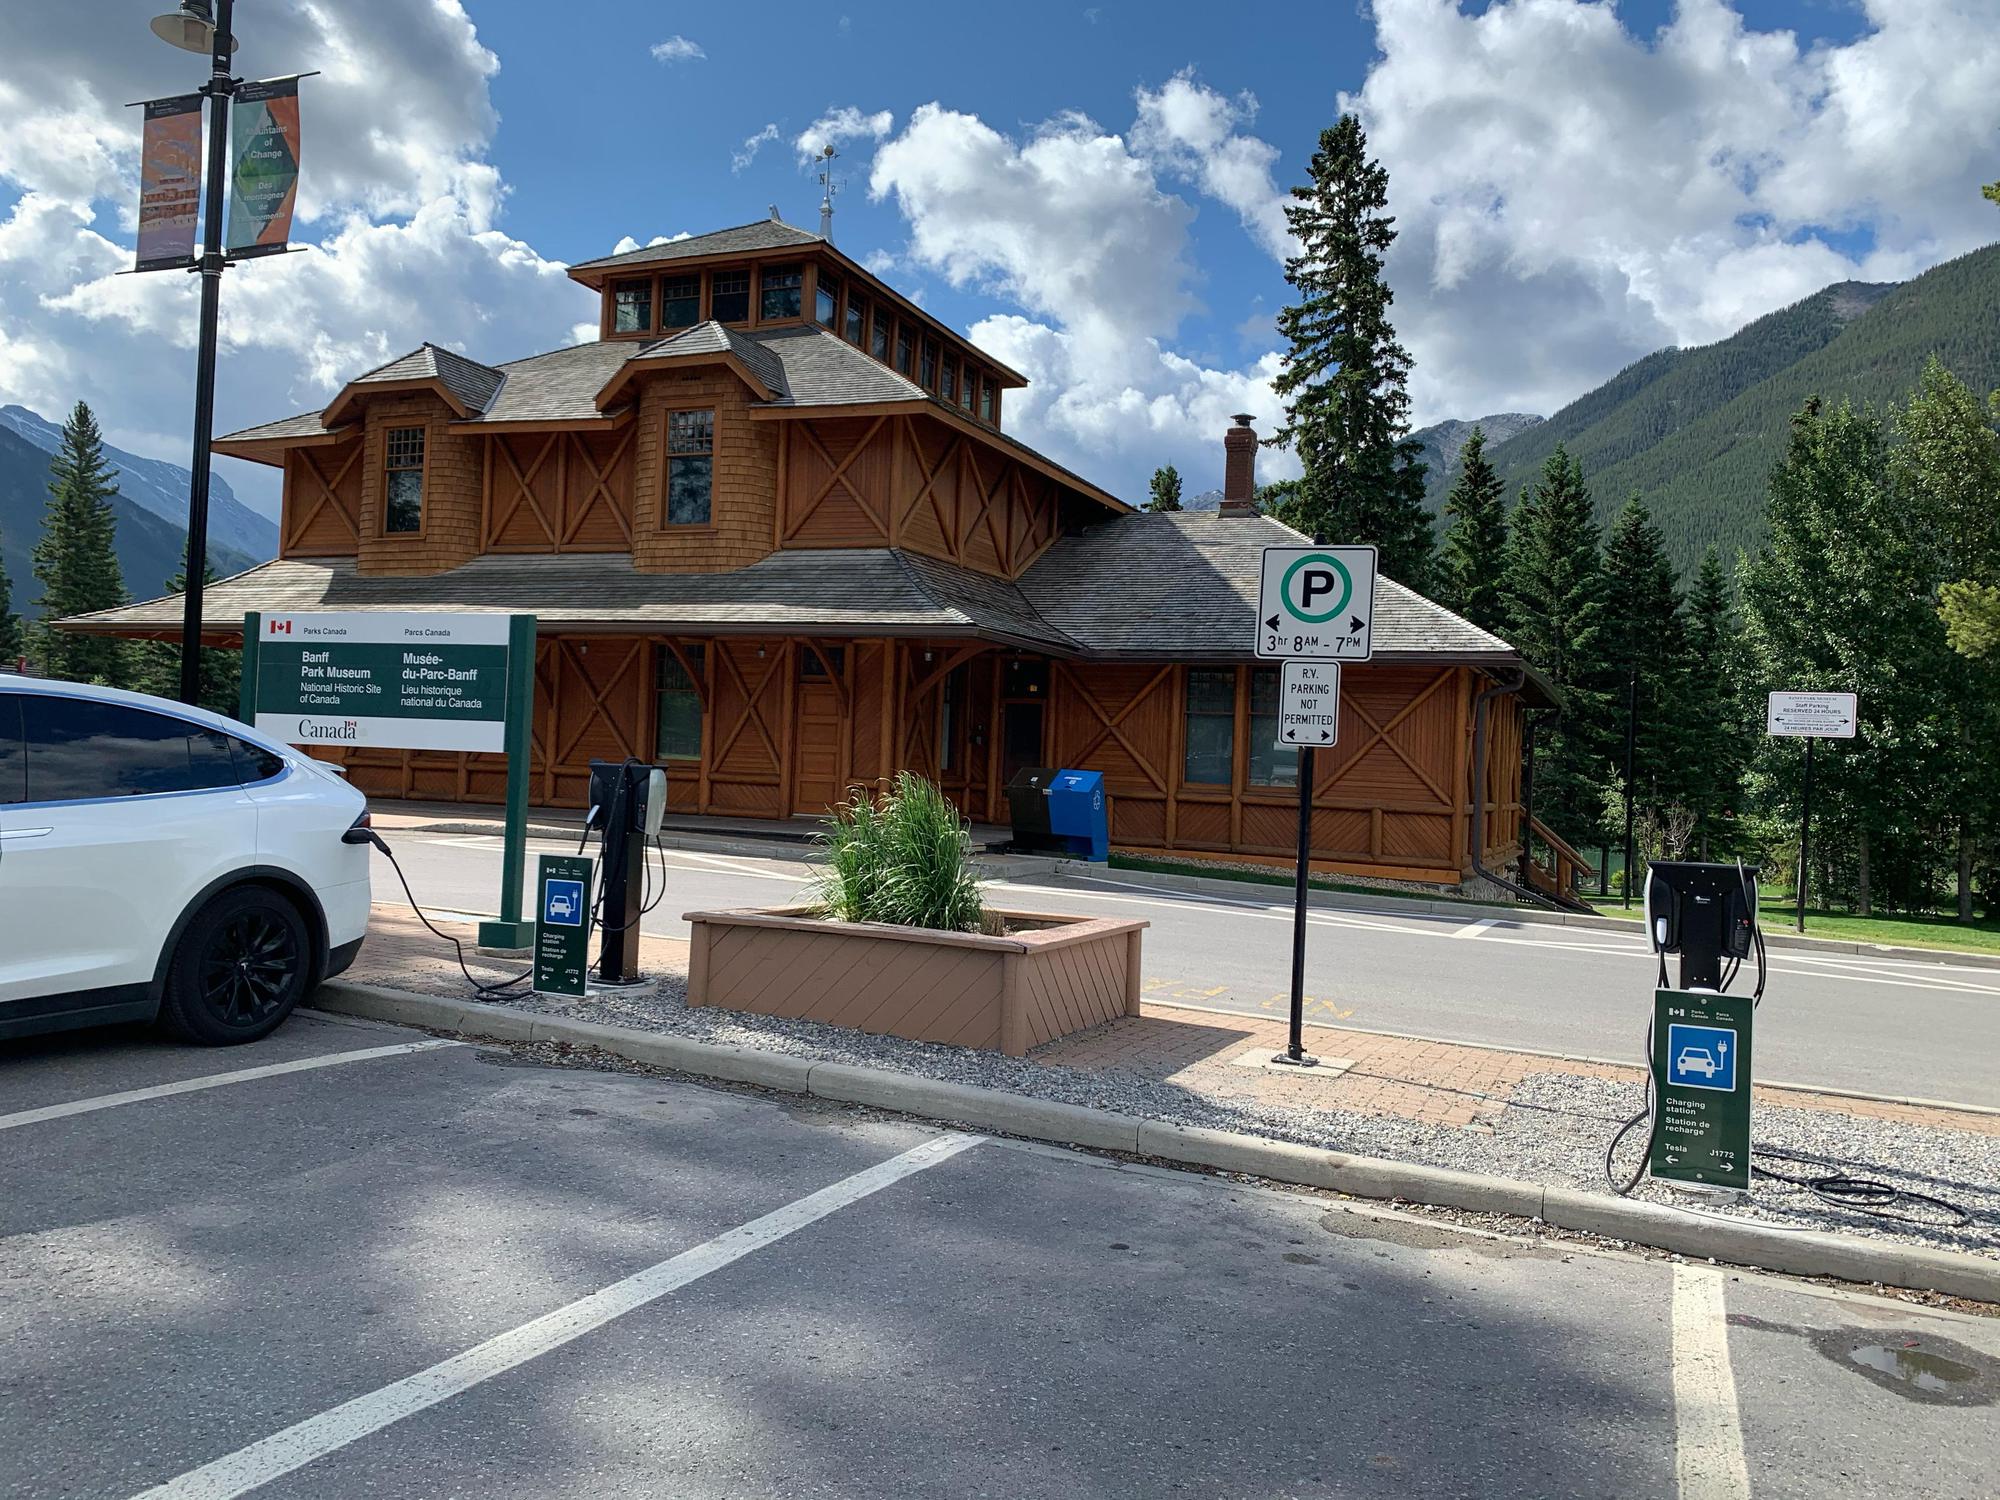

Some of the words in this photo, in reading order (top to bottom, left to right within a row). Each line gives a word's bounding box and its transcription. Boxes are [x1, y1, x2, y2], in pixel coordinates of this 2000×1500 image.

[264, 138, 273, 146] of
[251, 150, 282, 159] Change
[244, 192, 284, 201] montagnes
[1302, 570, 1335, 608] P
[303, 627, 322, 635] Parks
[404, 628, 423, 637] Parcs
[424, 629, 451, 637] Canada
[302, 651, 330, 664] Banff
[403, 652, 444, 665] Musée-
[301, 666, 324, 678] Park
[326, 667, 371, 679] Museum
[402, 668, 478, 681] du-Parc-Banff
[1302, 668, 1319, 679] R.V.
[300, 683, 333, 693] National
[334, 683, 364, 694] Historic
[365, 684, 382, 694] Site
[401, 684, 419, 695] Lieu
[420, 685, 463, 697] historique
[1291, 684, 1329, 695] PARKING
[299, 694, 307, 704] of
[308, 694, 340, 705] Canada
[400, 697, 434, 707] national
[435, 698, 447, 708] du
[448, 698, 482, 709] Canada
[1300, 699, 1318, 709] NOT
[1284, 715, 1333, 726] PERMITTED
[298, 718, 357, 739] Canada
[543, 932, 565, 941] Charging
[1666, 1097, 1706, 1110] Charging
[1666, 1106, 1696, 1116] station
[1665, 1117, 1697, 1127] Station
[1699, 1120, 1710, 1129] de
[1665, 1126, 1705, 1136] recharge
[1665, 1143, 1687, 1153] Tesla
[1709, 1149, 1735, 1159] J1772
